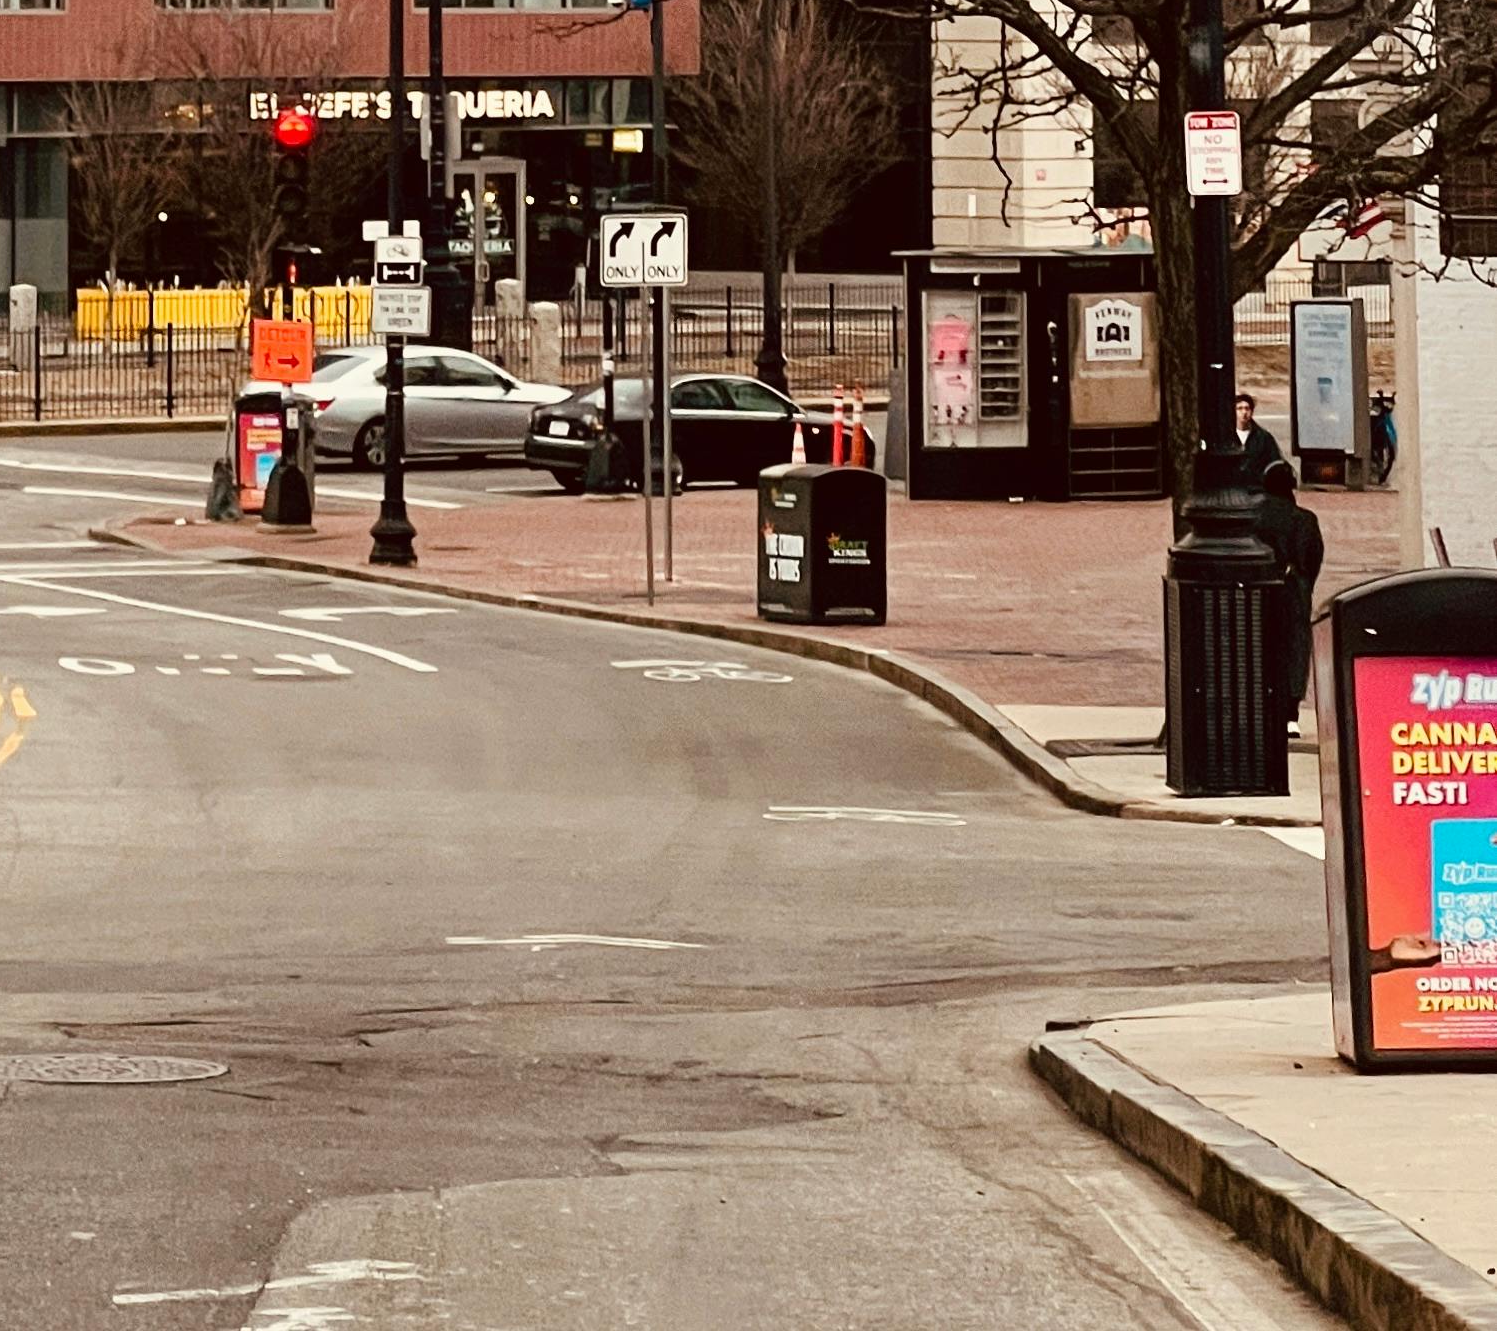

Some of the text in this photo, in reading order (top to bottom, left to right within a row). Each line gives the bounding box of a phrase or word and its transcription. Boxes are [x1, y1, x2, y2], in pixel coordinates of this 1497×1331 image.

[406, 90, 555, 119] TUERIA
[1204, 135, 1223, 144] NO
[606, 265, 681, 279] ONLY ONLY
[1095, 307, 1131, 319] FENWAY
[258, 327, 306, 342] DETOUR
[1392, 781, 1468, 806] FAST!
[1415, 976, 1471, 993] ORDER
